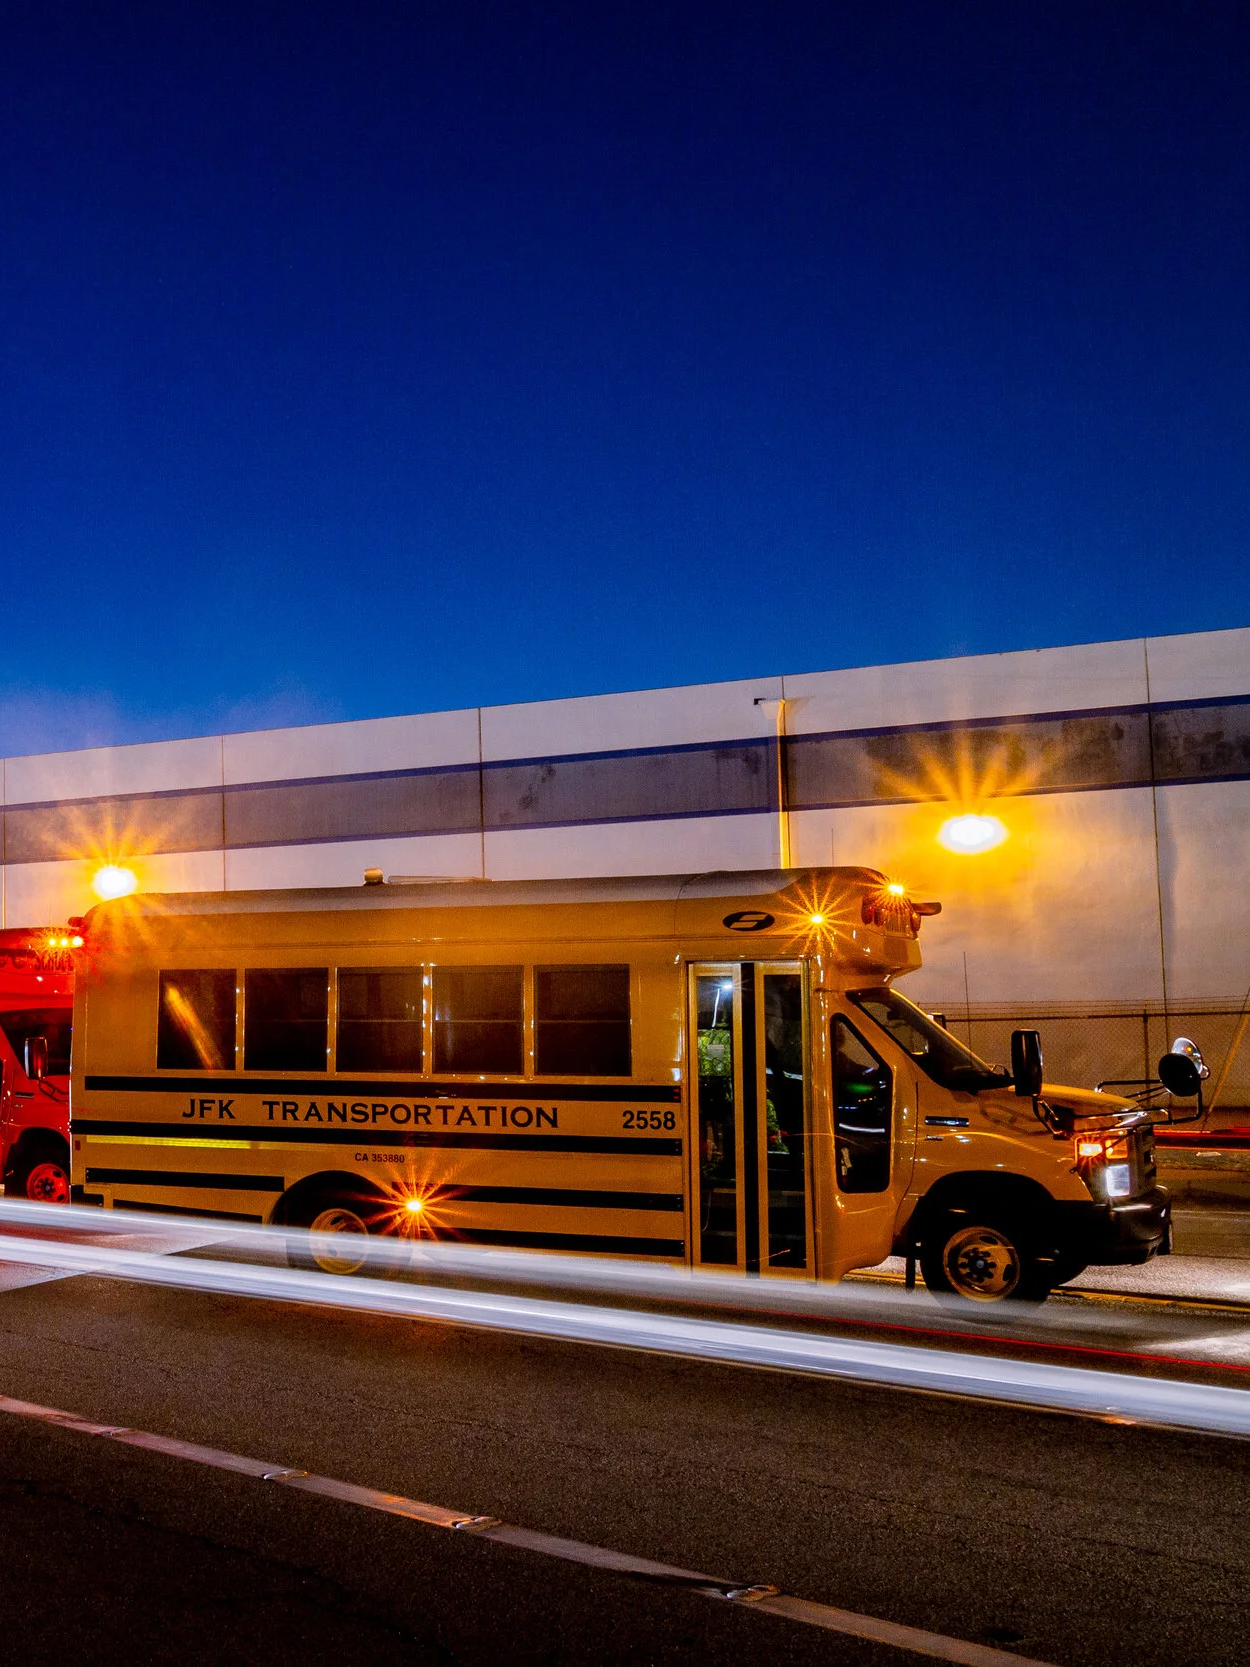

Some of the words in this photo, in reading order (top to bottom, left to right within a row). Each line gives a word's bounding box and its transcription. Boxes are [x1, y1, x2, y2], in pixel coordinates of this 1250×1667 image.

[182, 1098, 236, 1119] JFK
[262, 1100, 559, 1129] TRANSPORTATION
[622, 1110, 677, 1131] 2558
[354, 1152, 369, 1162] CA
